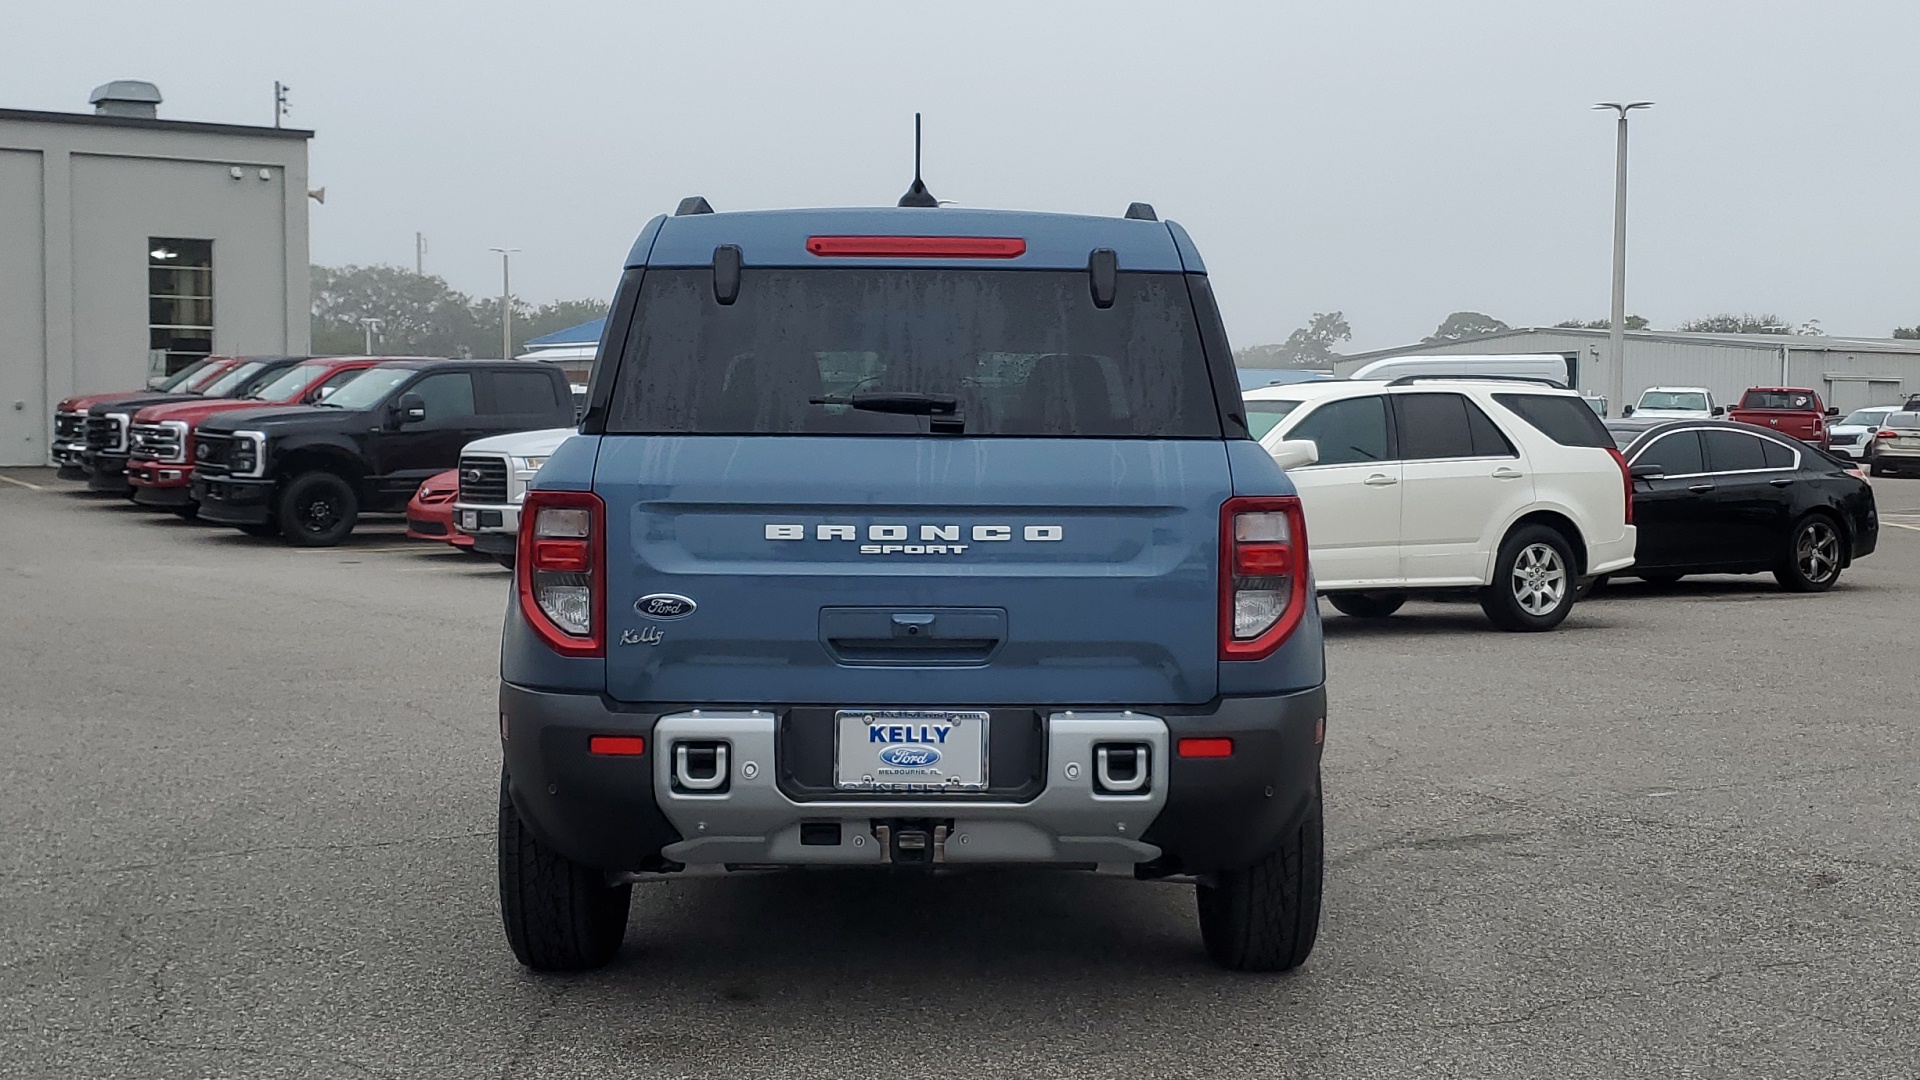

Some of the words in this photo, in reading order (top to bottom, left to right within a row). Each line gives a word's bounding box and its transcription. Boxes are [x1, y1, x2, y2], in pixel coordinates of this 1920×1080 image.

[764, 524, 1064, 542] BRONCO
[860, 544, 969, 555] SPORT
[647, 598, 682, 614] Ford
[619, 625, 665, 646] Kelly
[869, 726, 951, 744] KELLY
[890, 748, 928, 764] Ford
[872, 783, 949, 793] KELLY
